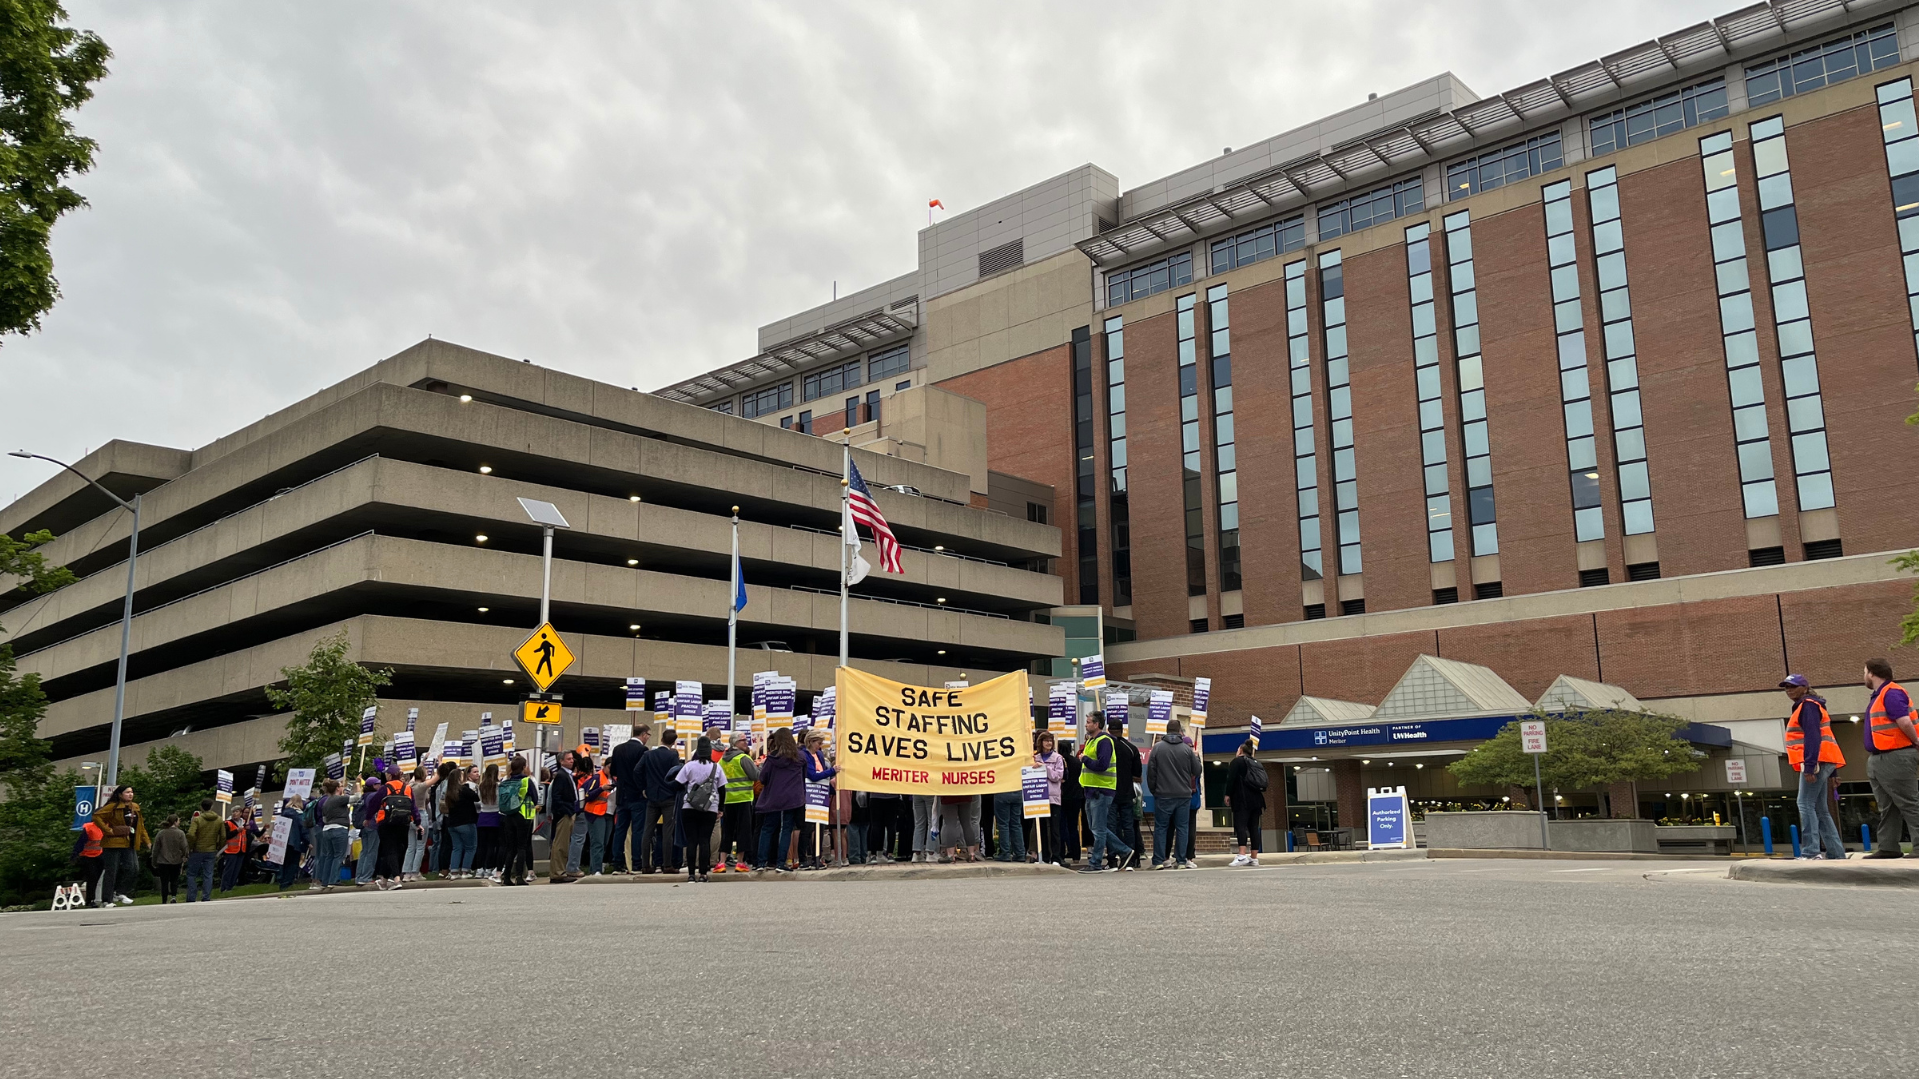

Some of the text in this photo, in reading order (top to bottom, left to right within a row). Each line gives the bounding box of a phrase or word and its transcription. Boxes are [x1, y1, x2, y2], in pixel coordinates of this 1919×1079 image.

[901, 687, 963, 707] SAFE
[875, 706, 989, 735] STAFFING
[1329, 730, 1360, 738] UnityPoint
[848, 732, 1016, 762] SAVES LIVES
[872, 767, 996, 785] MERITER NURSES
